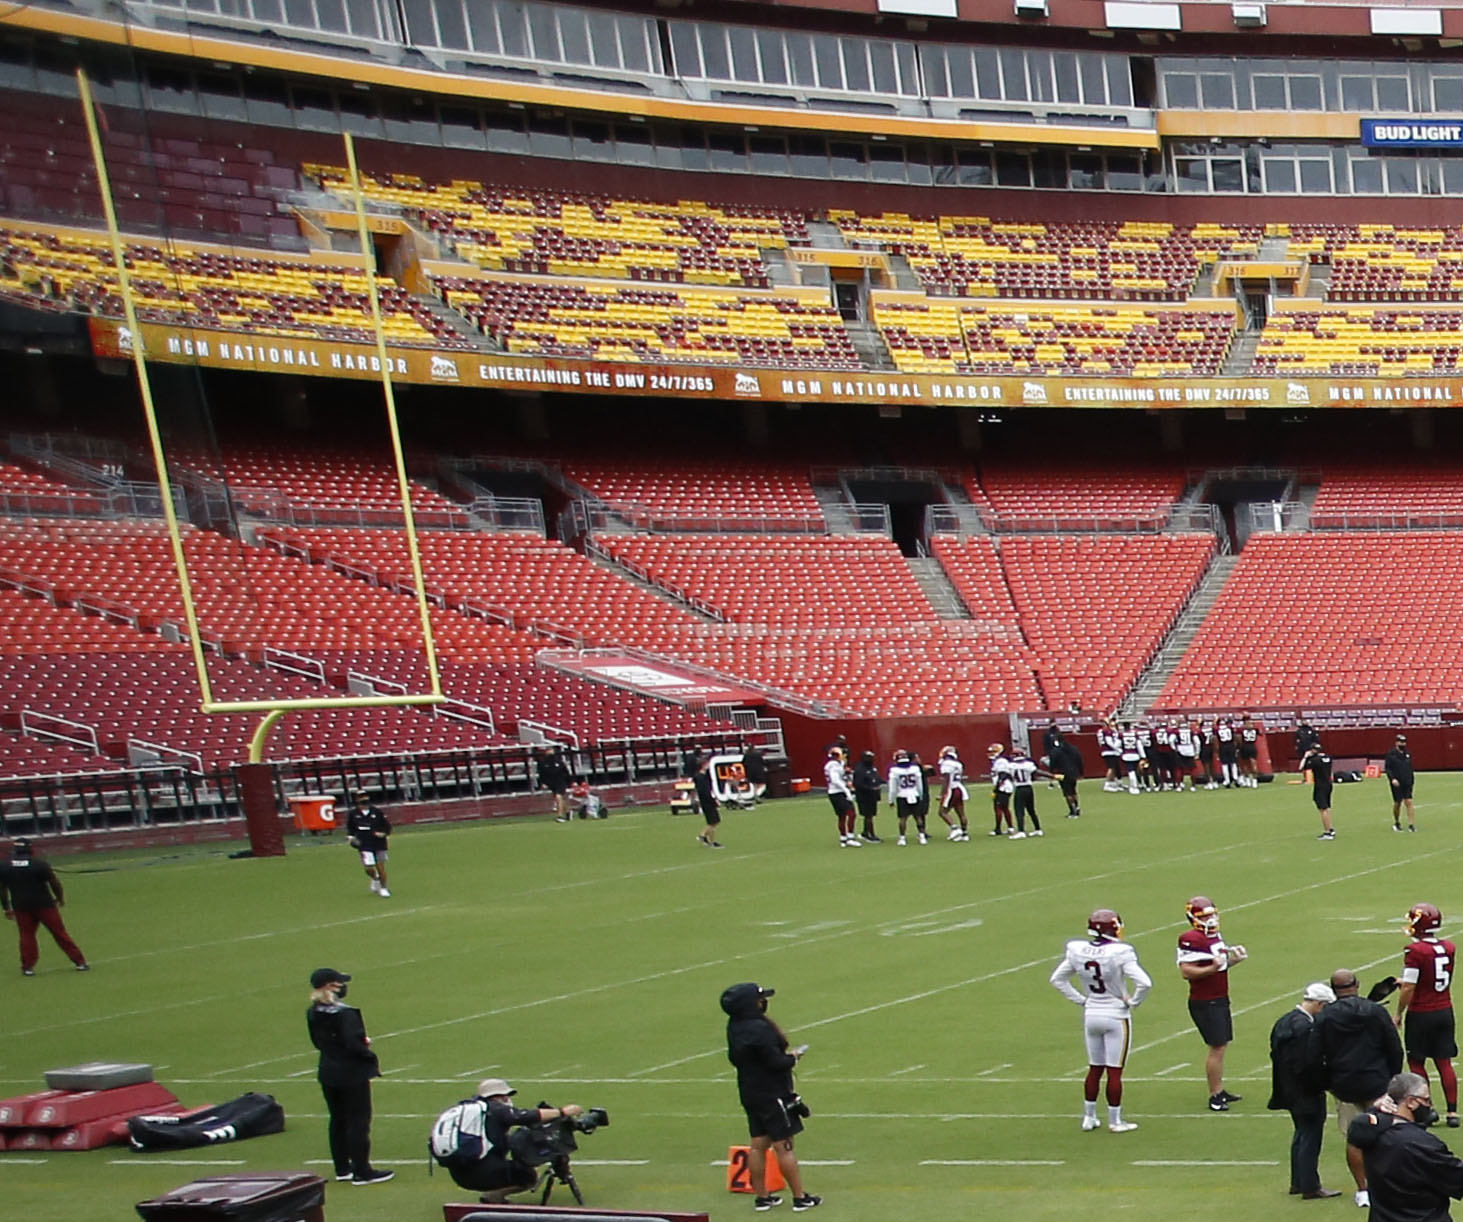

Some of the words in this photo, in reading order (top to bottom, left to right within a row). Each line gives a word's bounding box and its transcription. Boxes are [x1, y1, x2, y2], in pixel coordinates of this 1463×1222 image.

[1375, 126, 1411, 141] BUD
[1412, 126, 1462, 141] LIGHT
[378, 220, 397, 231] 315
[798, 252, 815, 263] 315
[169, 339, 208, 356] MGM
[220, 344, 319, 366] NATIONAL
[331, 354, 406, 373] HARBOR
[480, 365, 580, 384] ENTERTAINING
[585, 372, 610, 386] THE
[616, 374, 644, 387] DMV
[651, 376, 713, 390] 24/7/365
[782, 380, 821, 394] MGM
[832, 382, 922, 397] NATIONAL
[932, 384, 1001, 399] HARBOR
[1065, 387, 1155, 401] ENTERTAINING
[1158, 388, 1181, 400] THE
[1185, 388, 1210, 400] DMV
[1215, 387, 1270, 400] 24/7/365
[1329, 387, 1364, 400] MGM
[1373, 387, 1452, 400] NATIONAL
[102, 464, 124, 477] 214
[900, 774, 916, 788] 35
[320, 804, 334, 821] G
[1084, 961, 1106, 994] 3
[1435, 956, 1449, 991] 5
